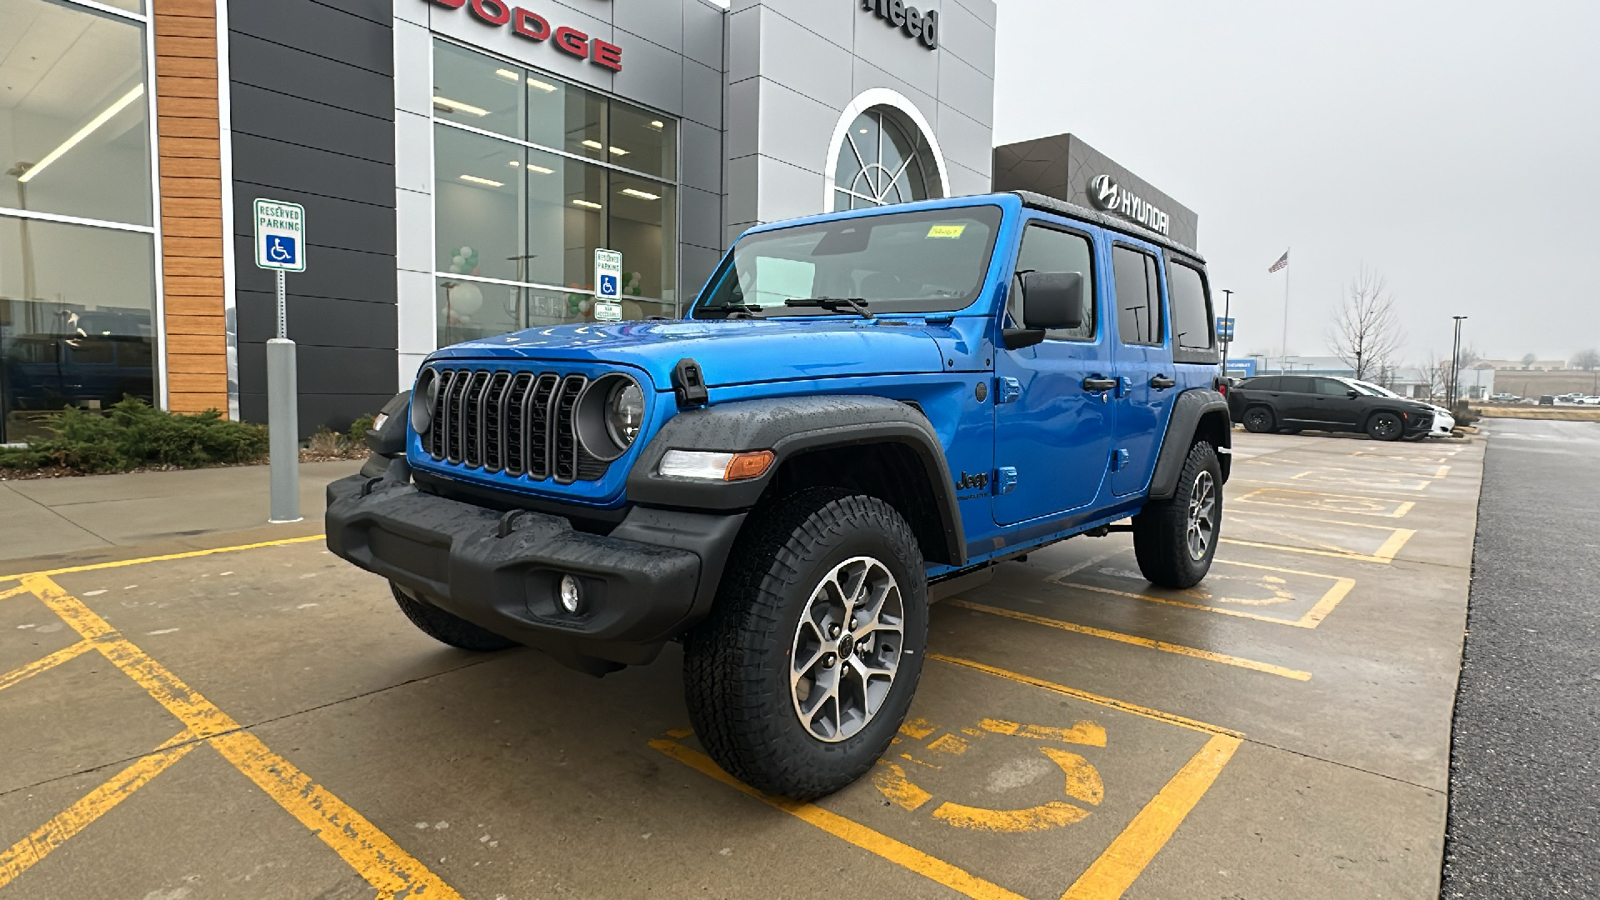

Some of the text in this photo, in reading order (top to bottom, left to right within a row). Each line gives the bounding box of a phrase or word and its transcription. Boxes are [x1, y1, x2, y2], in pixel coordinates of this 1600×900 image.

[425, 0, 622, 72] ODGE
[260, 206, 299, 219] RESERVED
[1121, 189, 1170, 235] HYUNDAI
[260, 218, 300, 231] PARKING
[598, 253, 619, 264] RESERVED
[598, 263, 619, 272] PARKING
[956, 470, 988, 490] Jeep
